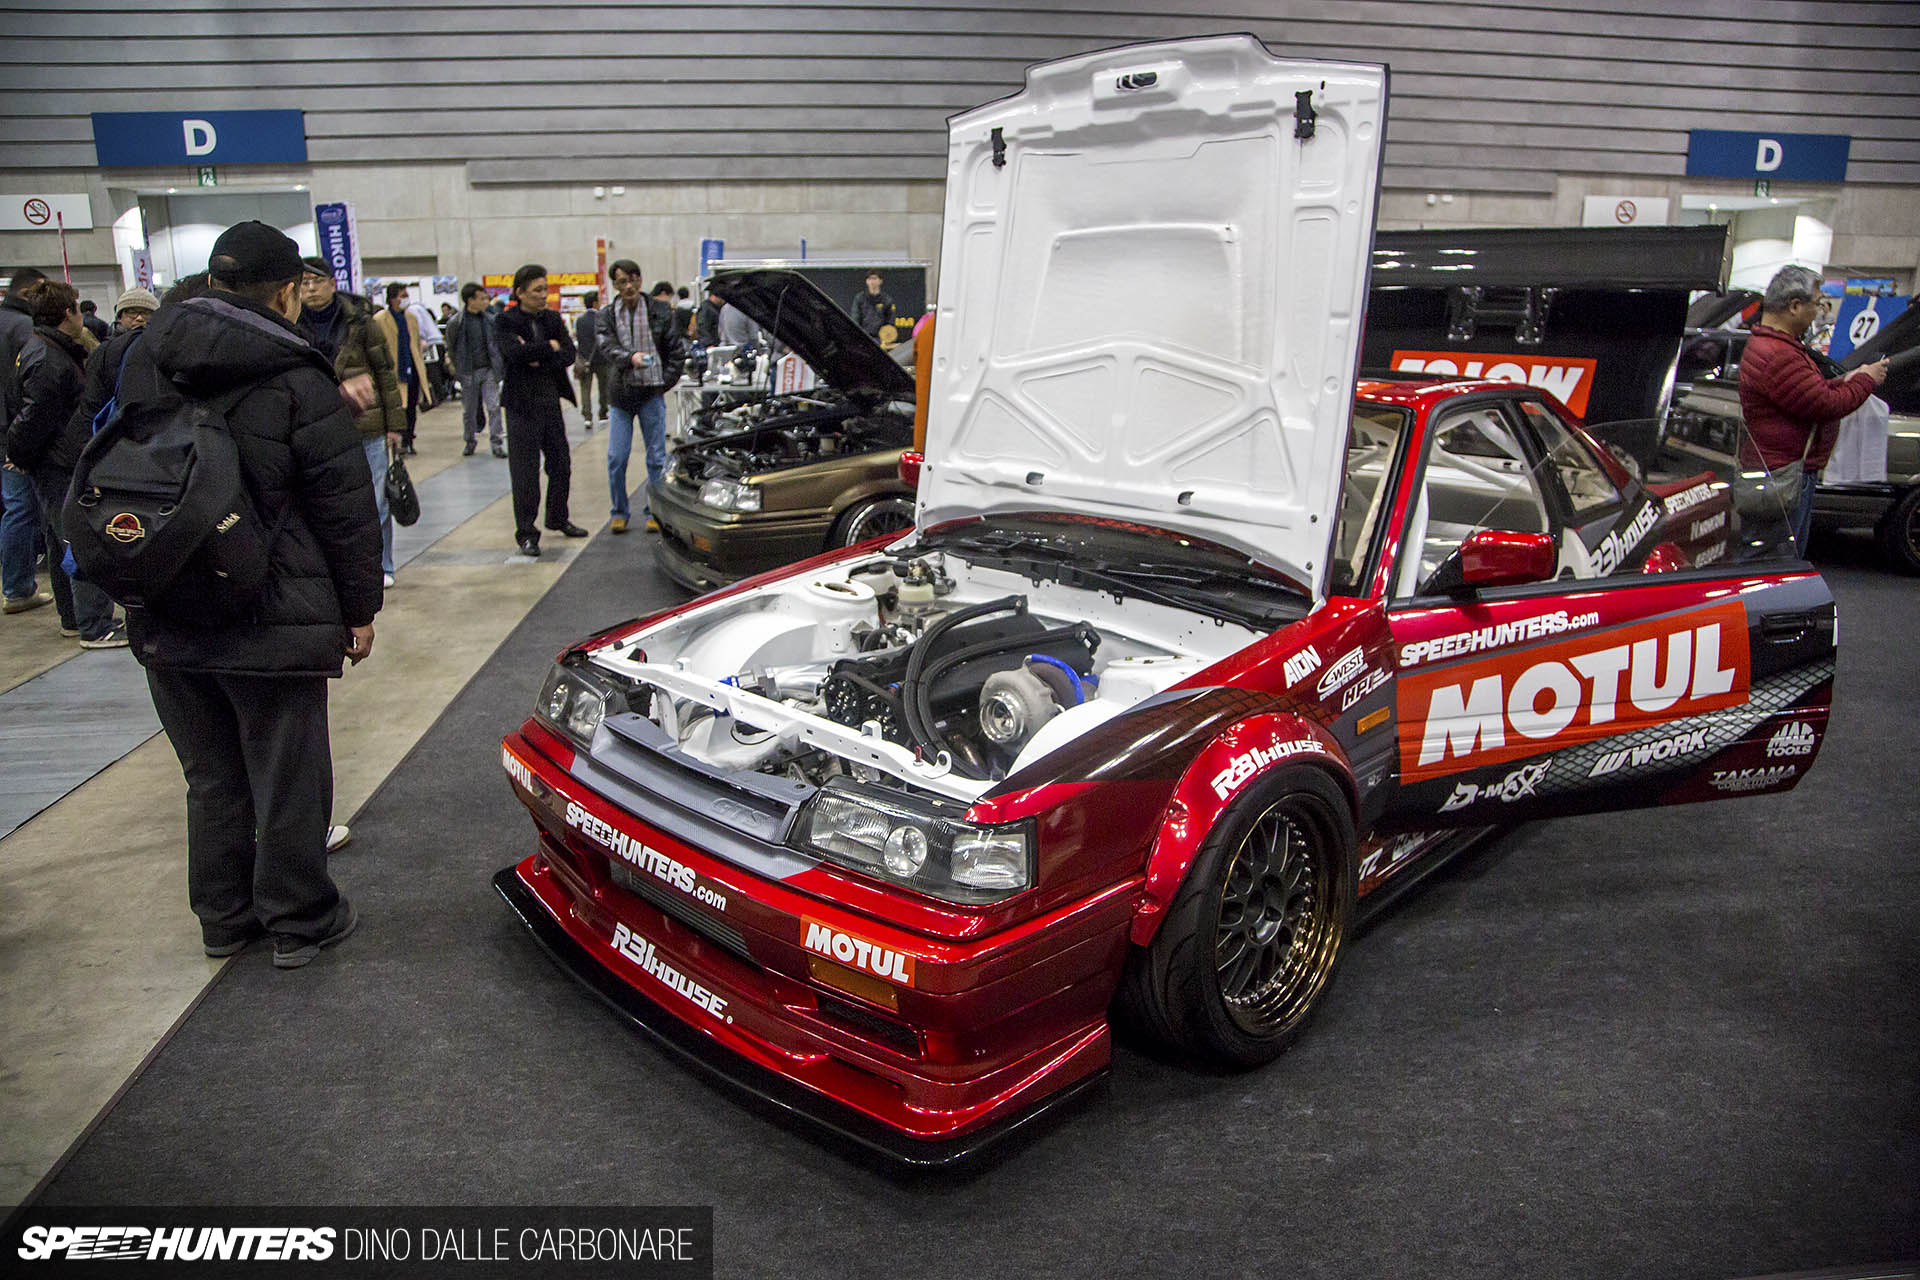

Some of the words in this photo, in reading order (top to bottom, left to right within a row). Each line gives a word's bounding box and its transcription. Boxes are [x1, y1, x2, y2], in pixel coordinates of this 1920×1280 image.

[183, 119, 217, 156] D
[1755, 139, 1782, 172] D
[1854, 316, 1876, 339] 27
[1400, 610, 1600, 667] SPEEDHUNTERS.com
[1417, 622, 1736, 767] MOTUL
[1631, 726, 1710, 768] WORK
[1767, 745, 1812, 758] TOOLS
[503, 748, 533, 793] MOTUL
[1709, 764, 1797, 786] TAKAMA
[565, 802, 727, 912] SPEEDHUNTERS.com
[804, 922, 910, 984] MOTUL
